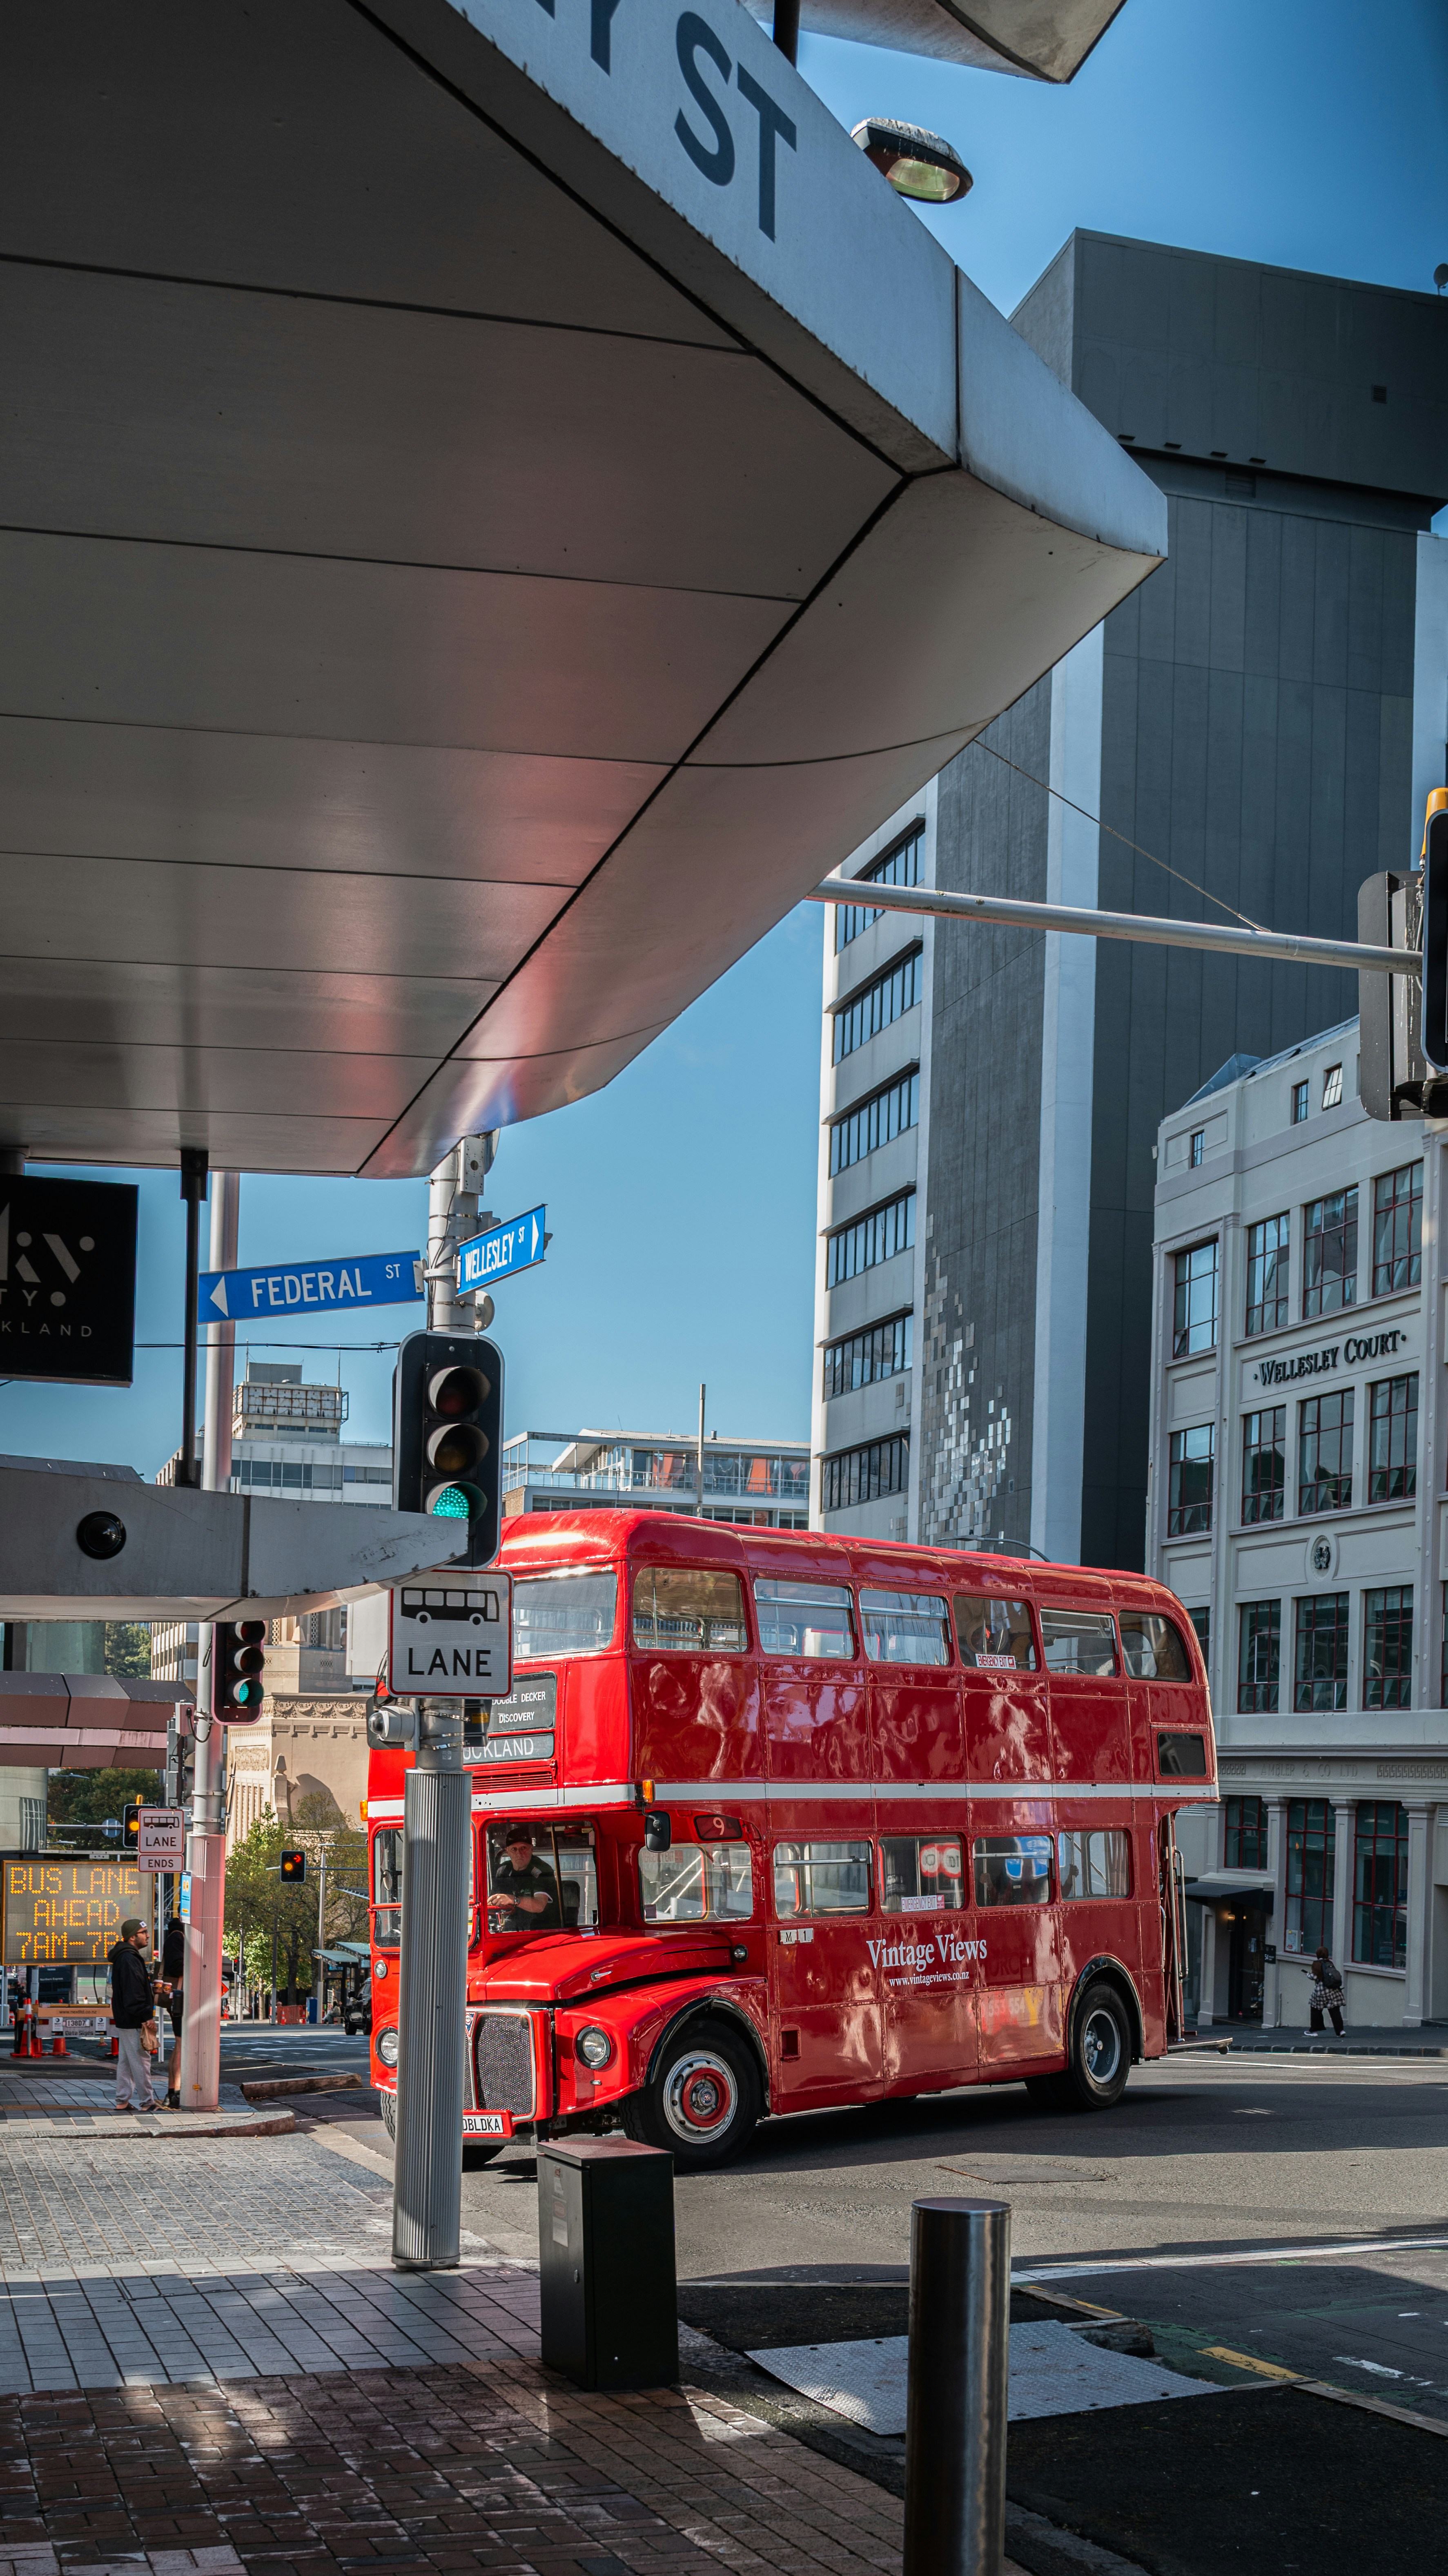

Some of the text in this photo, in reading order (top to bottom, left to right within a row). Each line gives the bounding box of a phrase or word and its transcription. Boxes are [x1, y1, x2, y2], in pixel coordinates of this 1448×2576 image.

[674, 11, 797, 244] ST
[465, 1226, 525, 1282] WELLESLEY ST
[251, 1264, 401, 1307] FEDERAL ST
[1, 1321, 92, 1337] KLAND
[1259, 1330, 1400, 1386] WELLESLEY COURT
[409, 1648, 491, 1677] LANE
[978, 1655, 999, 1667] EMERGENCY
[521, 1691, 546, 1703] DECKER
[499, 1711, 535, 1724] DISCOVERY
[463, 1738, 534, 1760] UCKLAND
[713, 1817, 724, 1835] 9
[146, 1837, 176, 1847] LANE
[148, 1860, 174, 1868] ENDS
[11, 1867, 140, 1894] BUS LANE
[34, 1899, 120, 1926] AHEAD
[902, 1897, 926, 1911] EMERGENCY
[928, 1896, 936, 1908] EXIT
[16, 1931, 124, 1959] 7AM-7P
[867, 1933, 987, 1972] Vintage Views
[889, 1971, 969, 1987] www.vintageviews.co.nz
